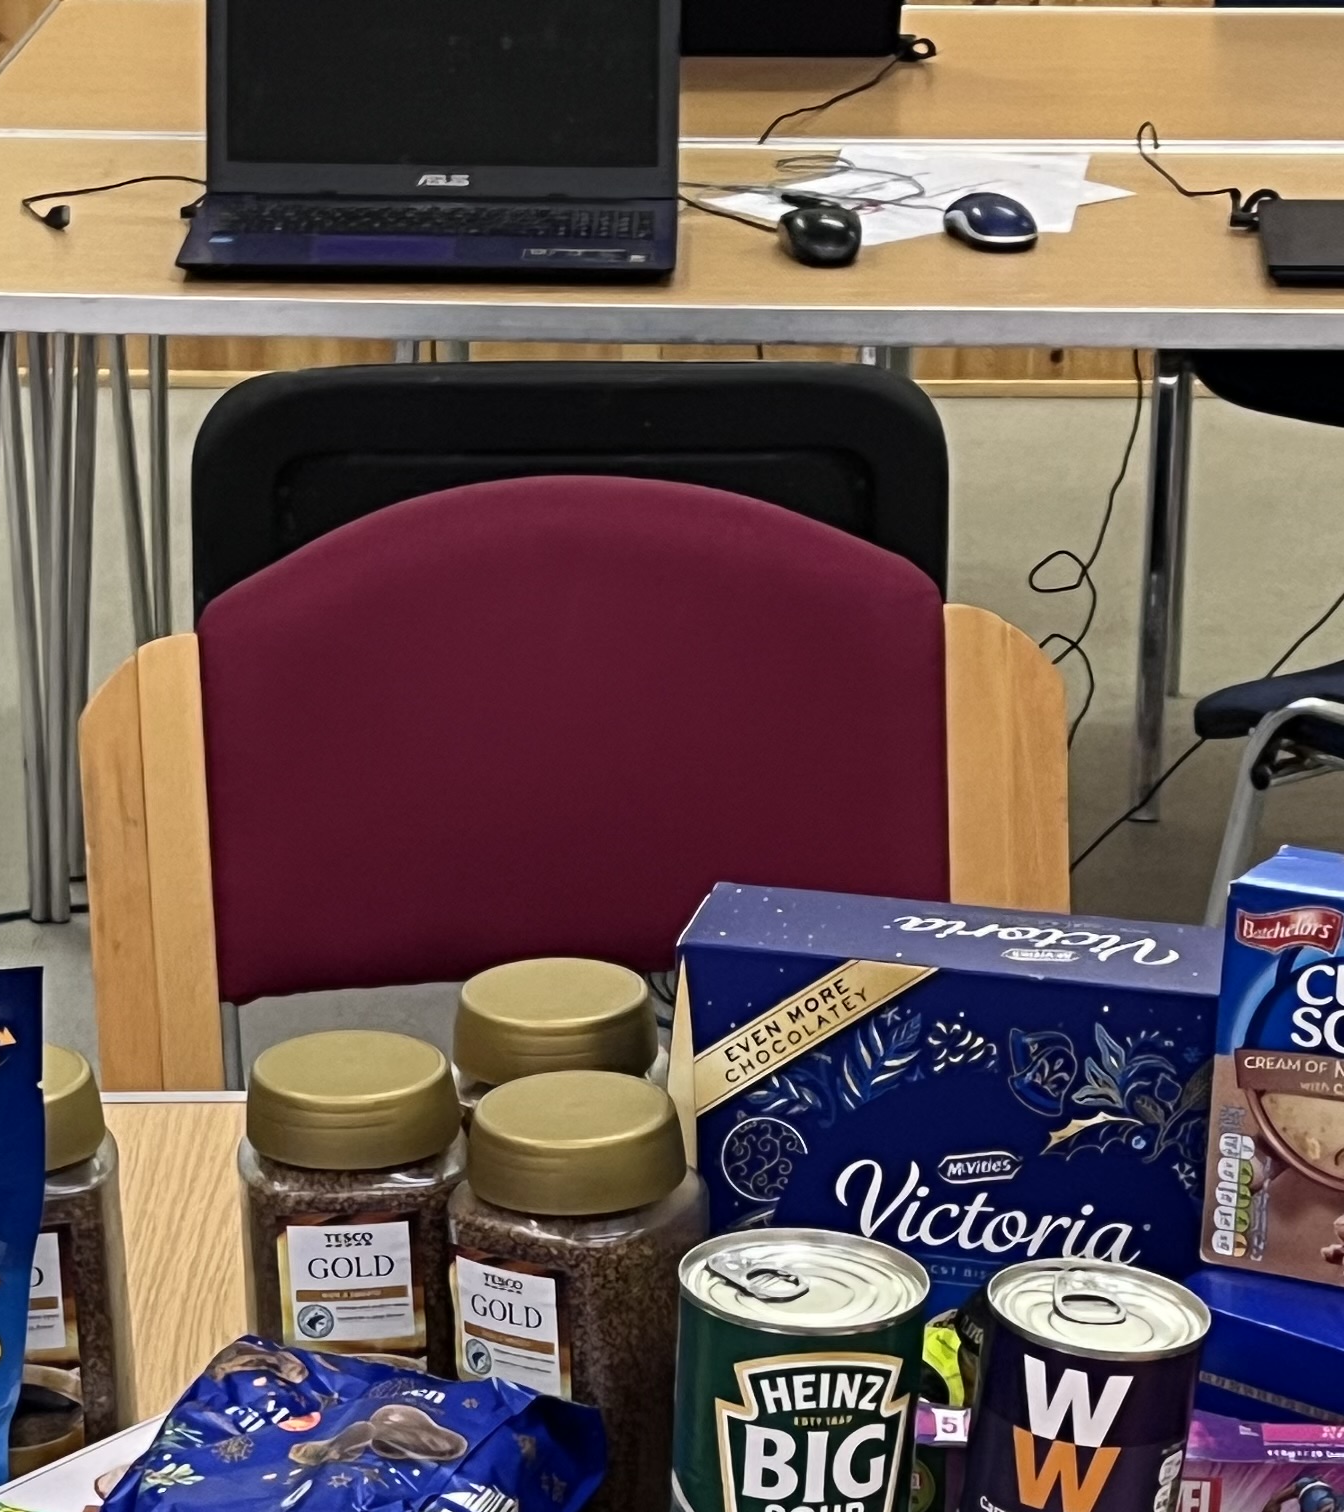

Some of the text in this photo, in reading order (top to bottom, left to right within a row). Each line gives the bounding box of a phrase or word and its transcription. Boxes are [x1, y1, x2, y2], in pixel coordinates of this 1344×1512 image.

[417, 174, 470, 187] ASUS
[893, 916, 1180, 966] Victoria
[1242, 918, 1334, 940] Batchelors
[725, 978, 850, 1063] EVEN MORE
[725, 988, 868, 1084] CHOCOLATEY
[1244, 1056, 1301, 1073] CREAM
[1305, 1060, 1327, 1074] OF
[835, 1158, 1145, 1264] Victoria
[308, 1255, 395, 1280] GOLD
[471, 1294, 543, 1330] GOLD
[760, 1373, 885, 1414] HEINZ
[1024, 1354, 1134, 1448] W
[742, 1424, 886, 1503] BIG
